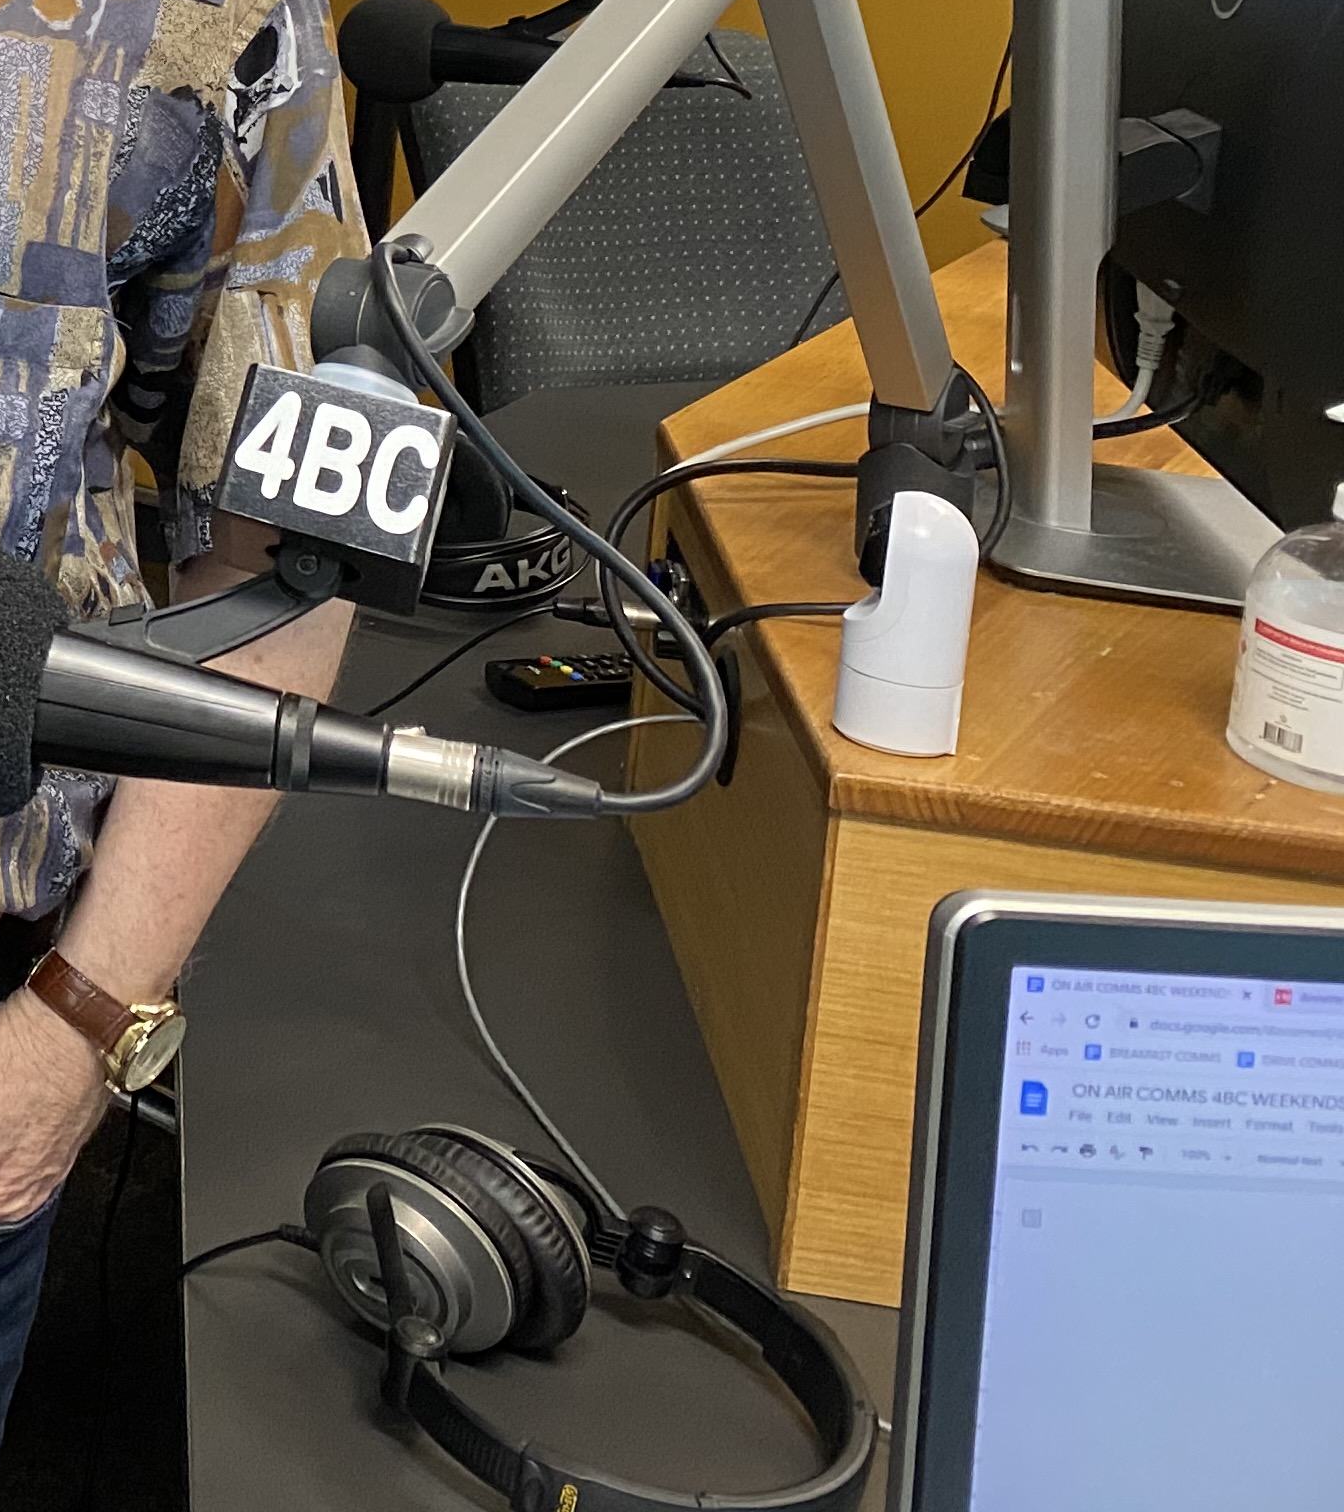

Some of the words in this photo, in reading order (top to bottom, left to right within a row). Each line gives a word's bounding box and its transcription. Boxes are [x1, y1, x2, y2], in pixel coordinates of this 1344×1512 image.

[234, 390, 441, 535] 4BC
[473, 536, 571, 593] AKG
[1072, 1082, 1101, 1099] ON
[1104, 1084, 1134, 1101] AIR
[1136, 1086, 1208, 1104] COMMS
[1211, 1090, 1248, 1107] 4BC
[1069, 1109, 1093, 1124] File
[1107, 1111, 1132, 1125] Edit
[1146, 1113, 1179, 1127] View
[1192, 1116, 1231, 1130] Insert
[1245, 1118, 1294, 1134] Format
